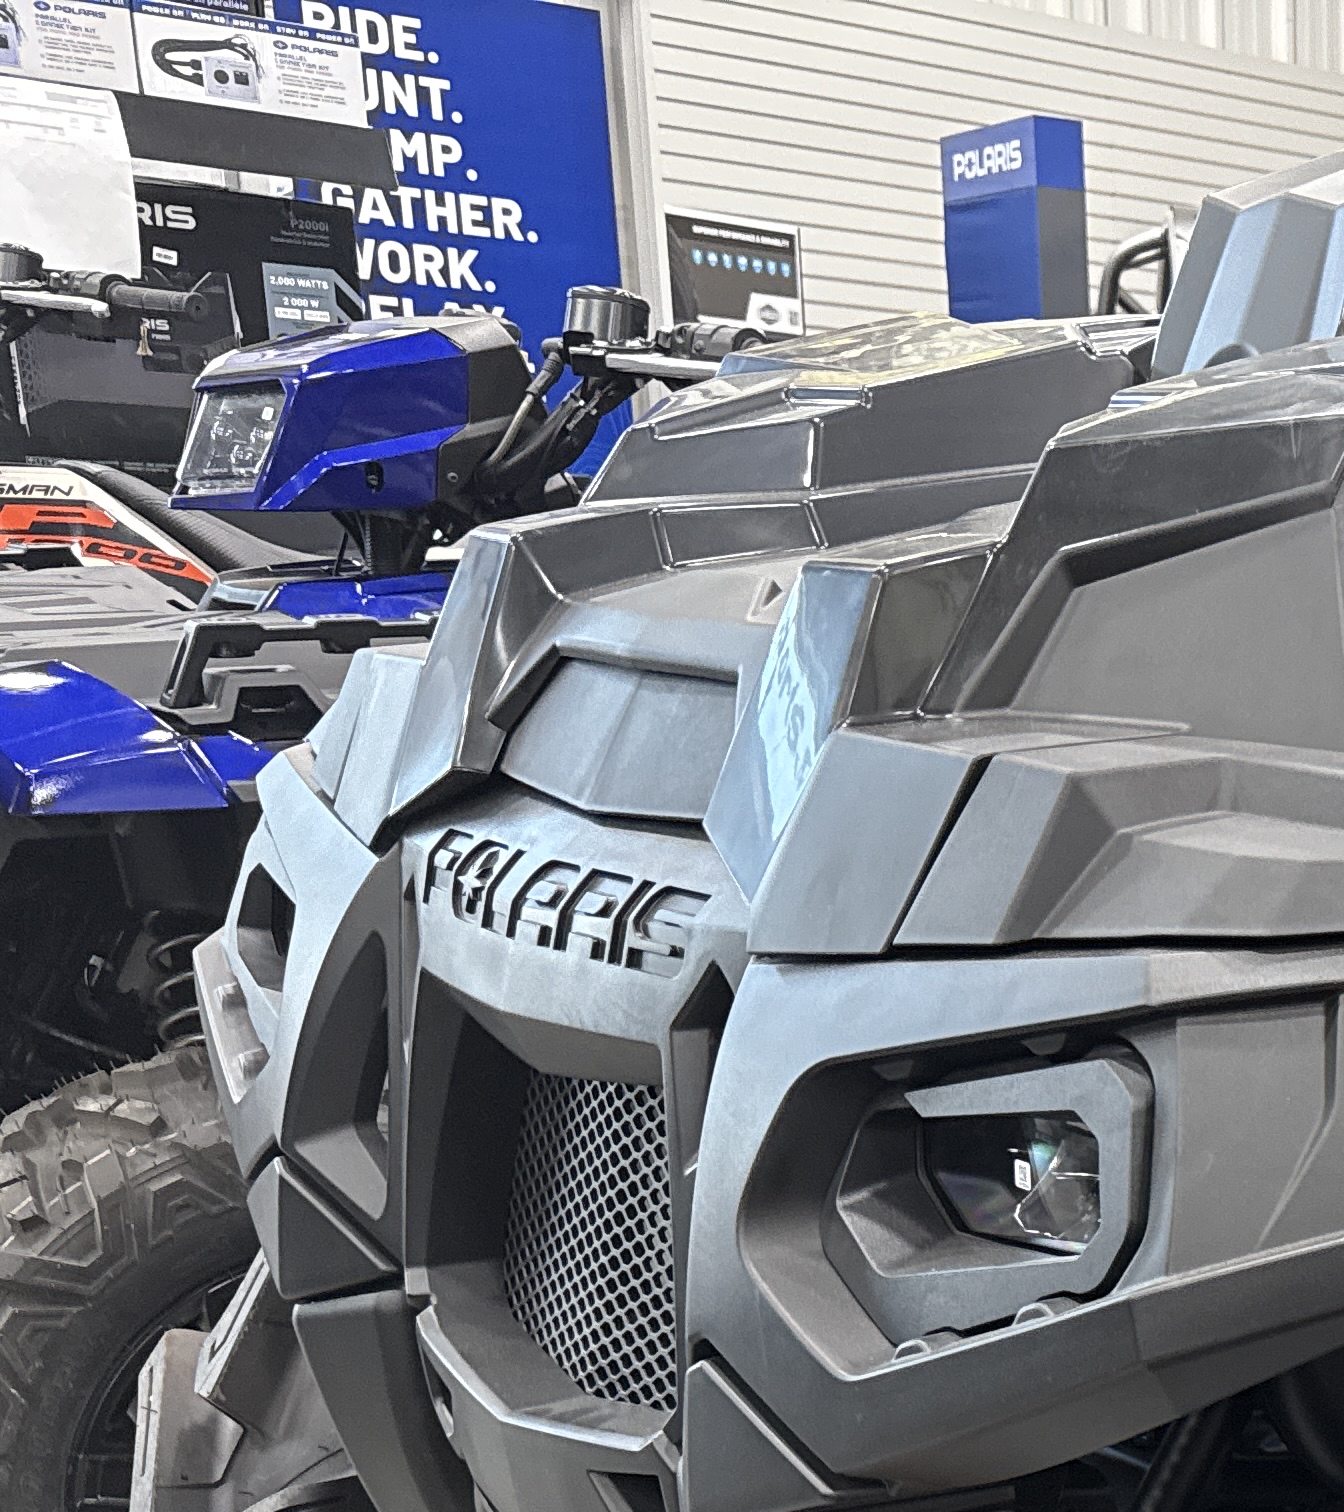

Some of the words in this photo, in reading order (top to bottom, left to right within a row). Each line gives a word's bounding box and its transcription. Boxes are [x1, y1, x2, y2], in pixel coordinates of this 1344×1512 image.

[389, 127, 478, 183] MP.
[952, 139, 1023, 183] POLARIS
[321, 181, 539, 244] GATHER.
[422, 828, 713, 980] POLARIS
